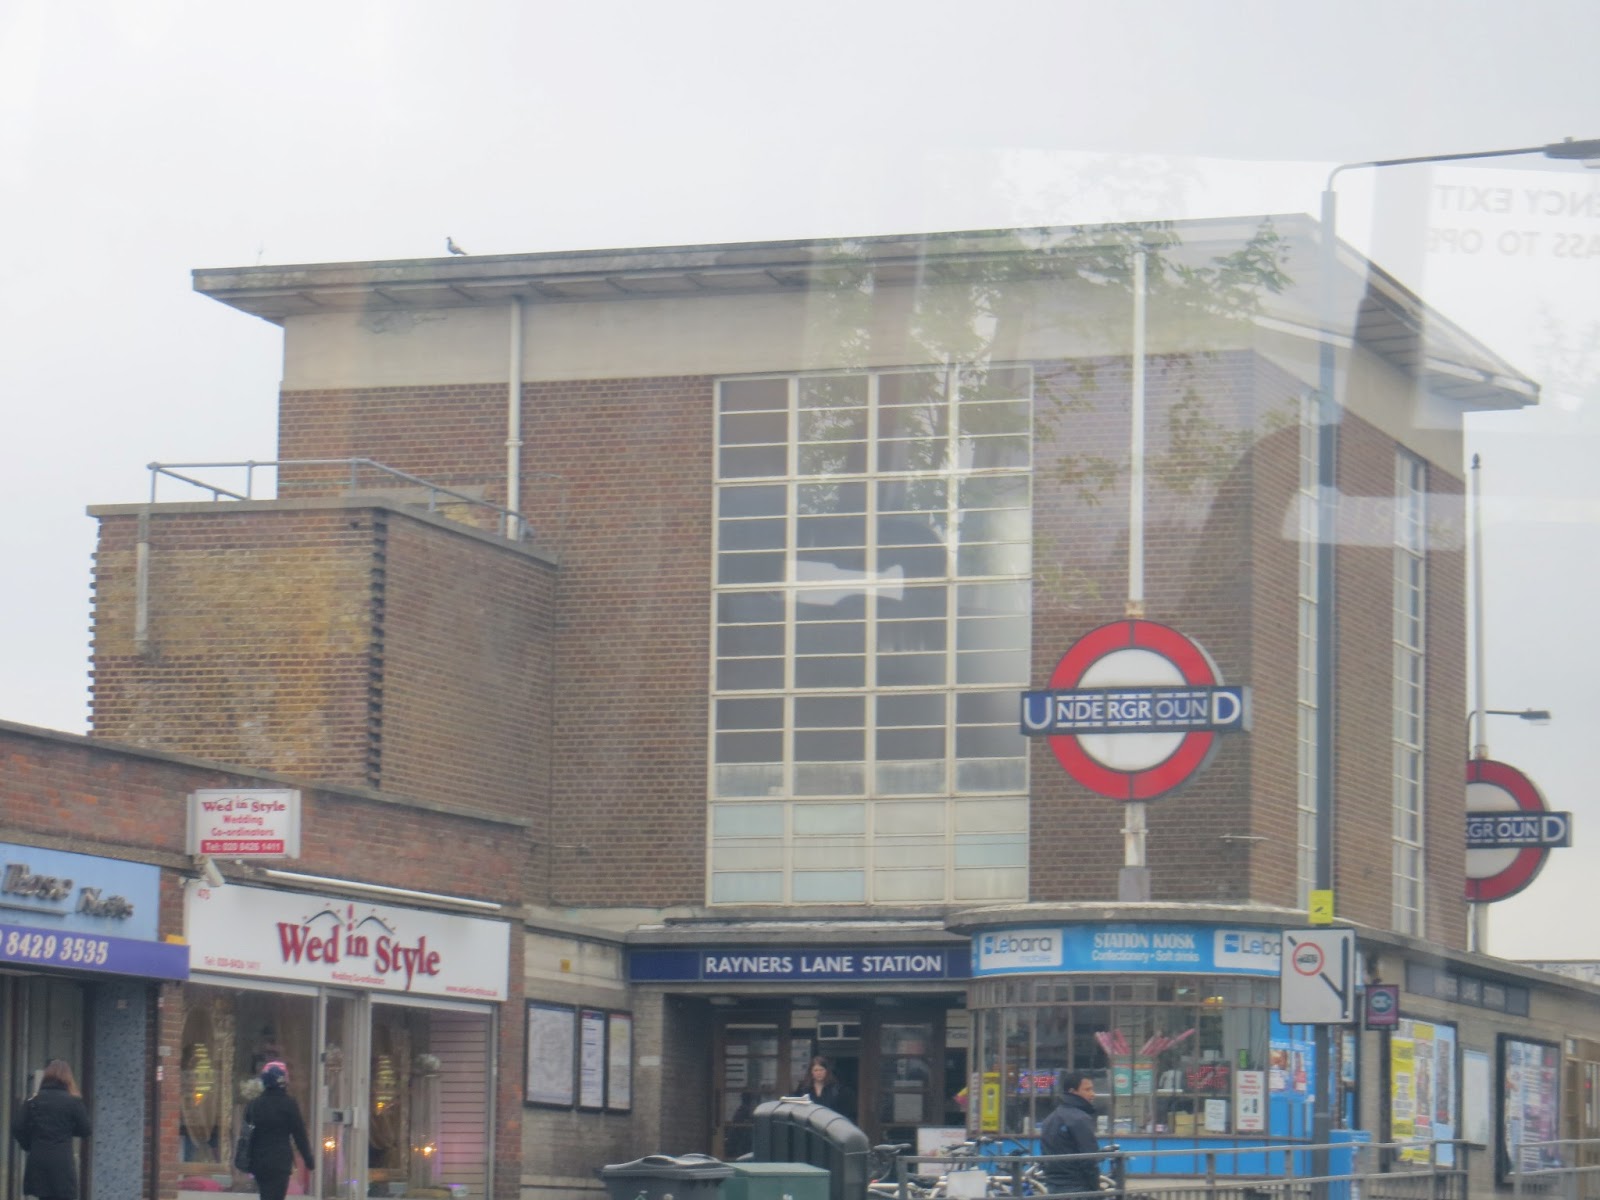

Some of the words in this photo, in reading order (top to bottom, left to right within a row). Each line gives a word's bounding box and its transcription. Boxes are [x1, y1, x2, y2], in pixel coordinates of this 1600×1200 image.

[1023, 690, 1242, 730] UNDERGROUND
[201, 800, 233, 812] Wed
[251, 800, 286, 813] Style
[222, 815, 264, 825] Wedding
[1466, 816, 1565, 842] GROUND
[6, 931, 58, 960] 8429
[60, 937, 110, 966] 3535
[994, 934, 1052, 954] Lebara
[1094, 932, 1149, 949] STATION
[1241, 934, 1282, 956] Leba
[277, 922, 340, 965] Wed
[345, 922, 369, 958] in
[374, 935, 441, 992] Style
[705, 955, 793, 974] RAYNERS
[801, 955, 854, 973] LANE
[862, 954, 942, 973] STATION
